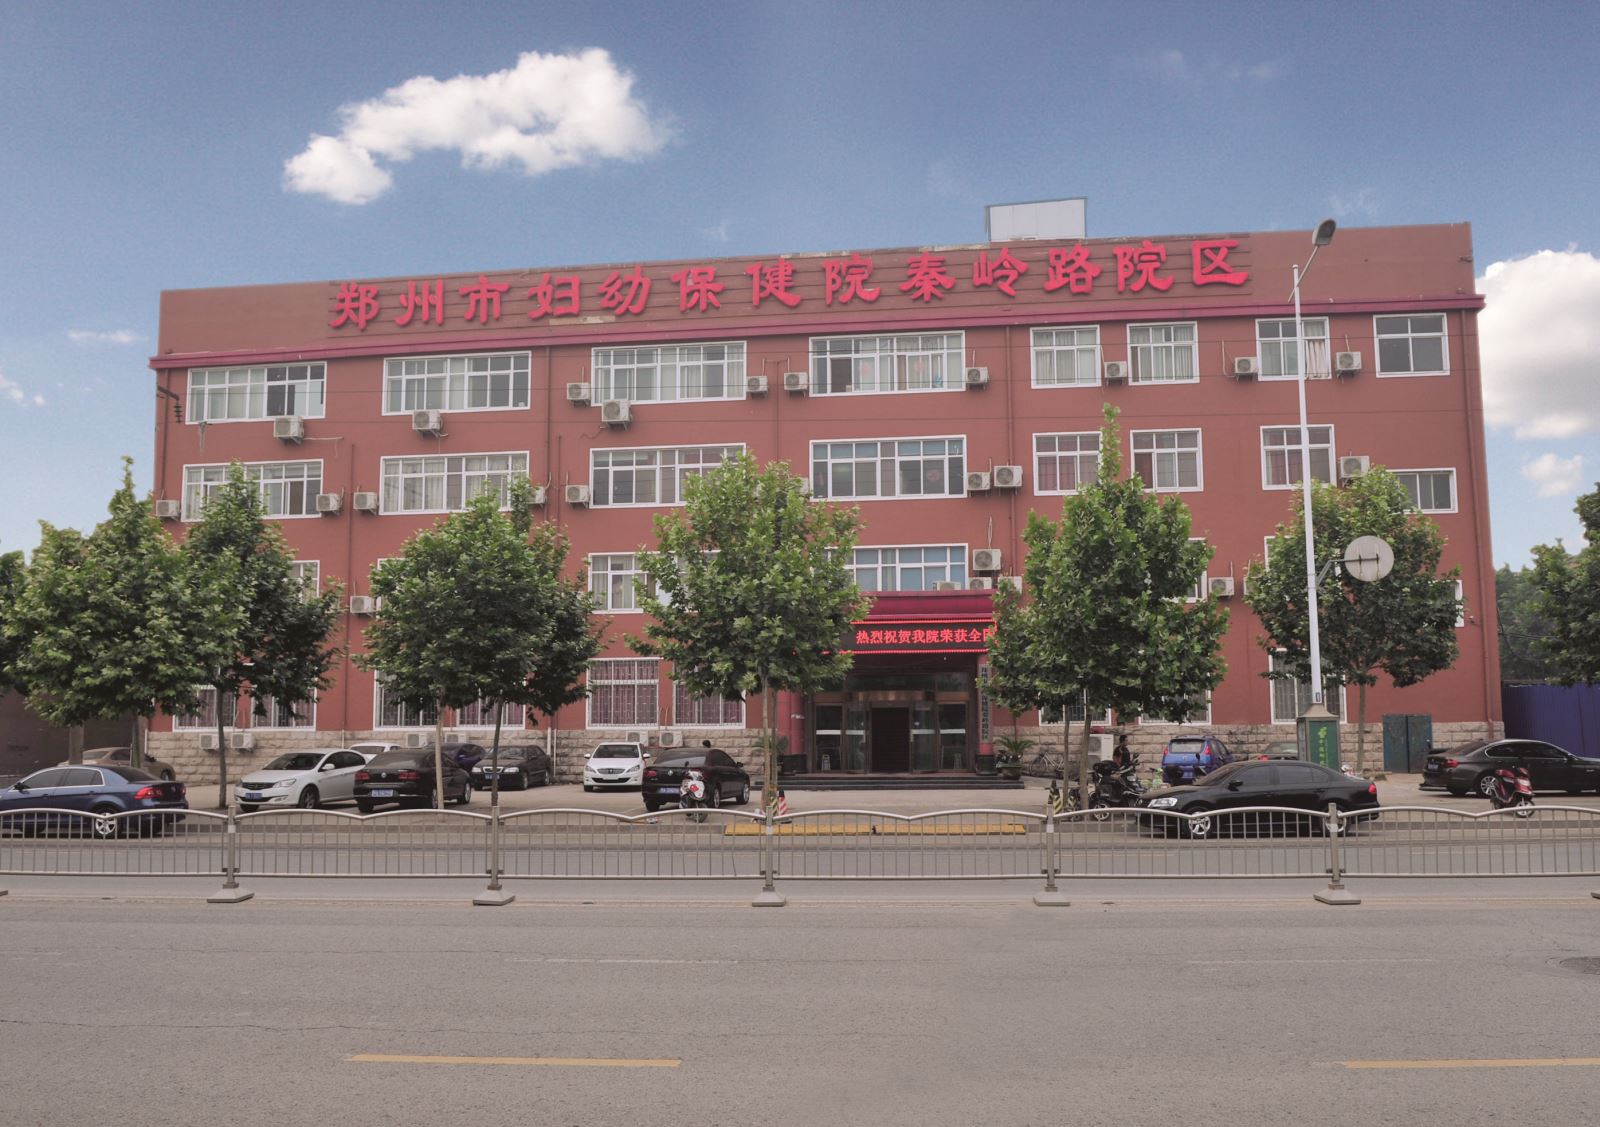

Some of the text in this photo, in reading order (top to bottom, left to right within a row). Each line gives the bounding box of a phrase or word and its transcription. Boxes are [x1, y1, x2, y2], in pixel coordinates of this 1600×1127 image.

[328, 239, 1250, 332] 郑州市妇幼保健院秦岭路院区
